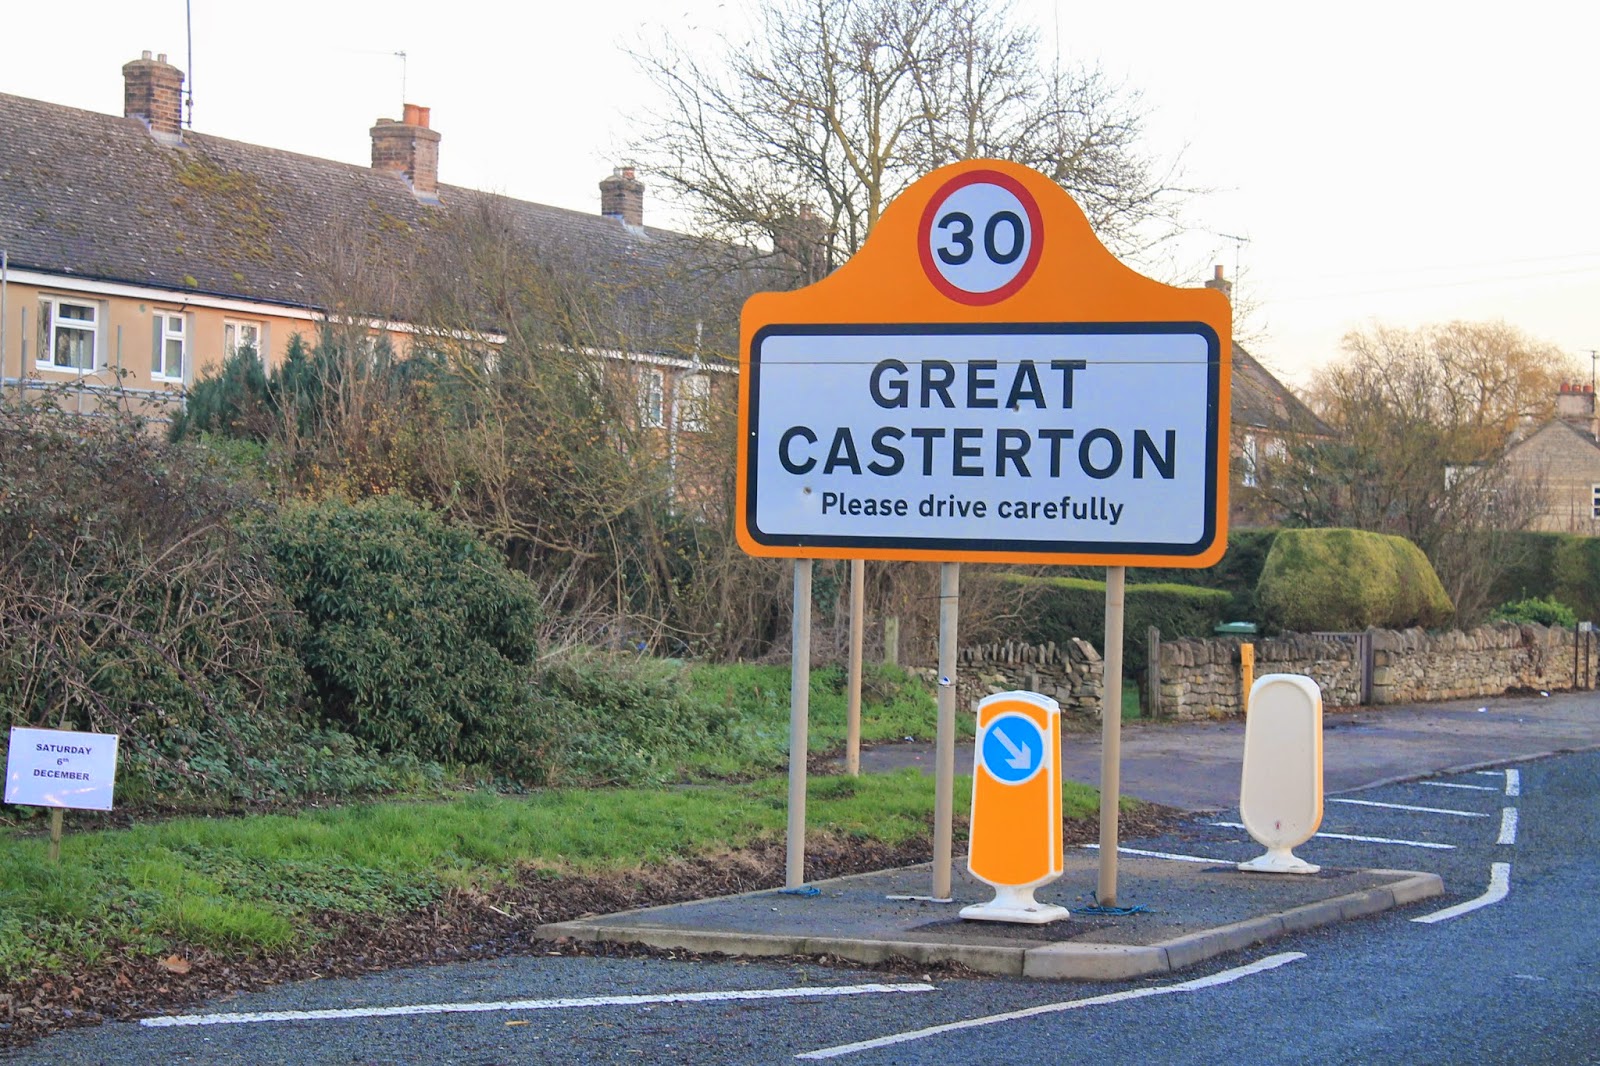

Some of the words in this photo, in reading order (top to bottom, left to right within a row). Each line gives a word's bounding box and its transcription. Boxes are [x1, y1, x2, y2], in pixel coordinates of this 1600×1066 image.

[936, 210, 1026, 266] 30
[869, 358, 1087, 410] GREAT
[778, 425, 1176, 480] CASTERTON
[822, 492, 908, 517] Please
[918, 493, 987, 518] drive
[997, 496, 1125, 526] carefully
[36, 743, 92, 755] SATURDAY
[56, 757, 70, 766] 6th
[33, 768, 90, 781] DECEMBER
